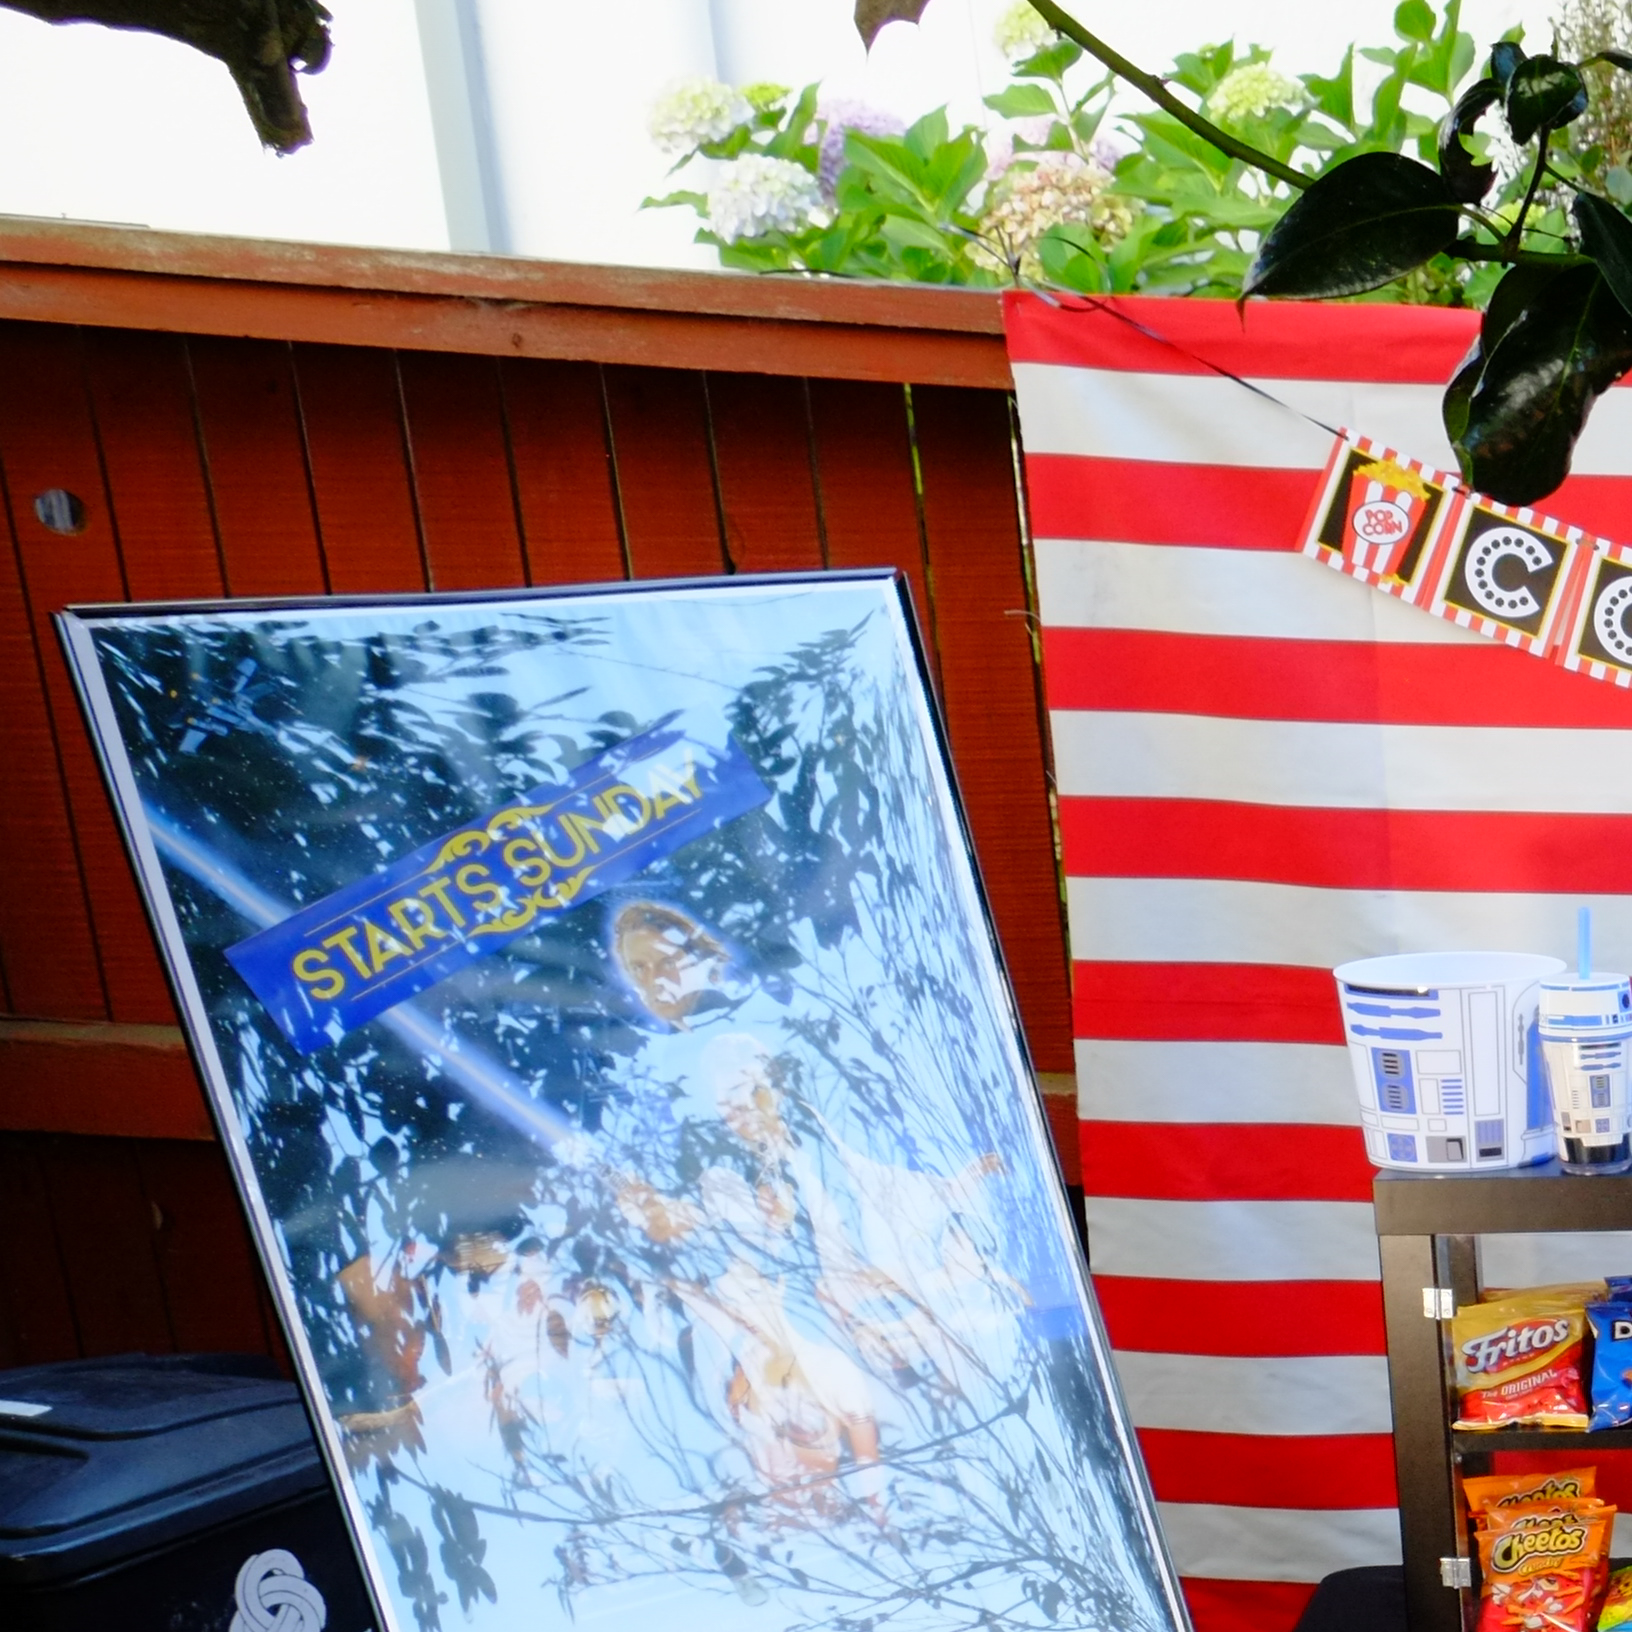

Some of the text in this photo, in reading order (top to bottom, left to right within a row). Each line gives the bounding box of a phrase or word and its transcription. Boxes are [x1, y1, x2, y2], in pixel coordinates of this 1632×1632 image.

[292, 748, 704, 1000] STARTS SUNDAY
[1462, 1318, 1570, 1373] Fritos
[1500, 1369, 1557, 1397] ORIGINAL
[1494, 1526, 1584, 1569] Cheetos
